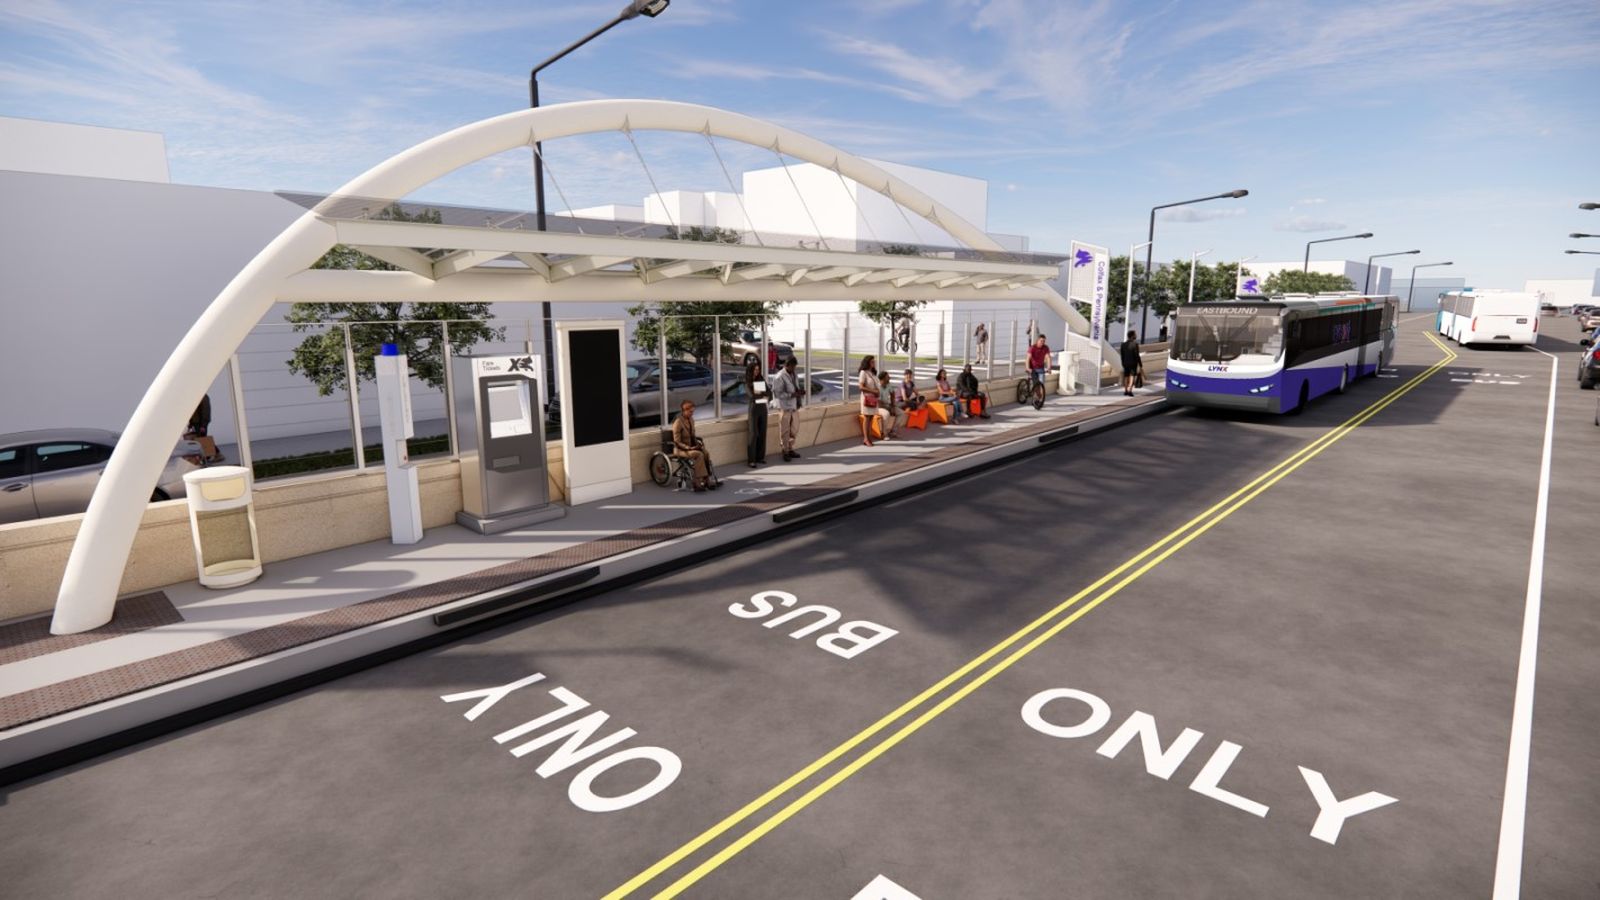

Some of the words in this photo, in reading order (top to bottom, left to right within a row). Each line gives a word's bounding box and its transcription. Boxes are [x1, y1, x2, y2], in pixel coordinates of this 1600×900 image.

[1097, 261, 1106, 284] Colfax
[1092, 293, 1104, 341] Pennsylvania
[1196, 306, 1258, 316] EASTBOUND
[1207, 365, 1229, 373] LYNX
[729, 591, 898, 659] BUS
[441, 673, 681, 812] ONLY
[1022, 688, 1397, 845] ONLY
